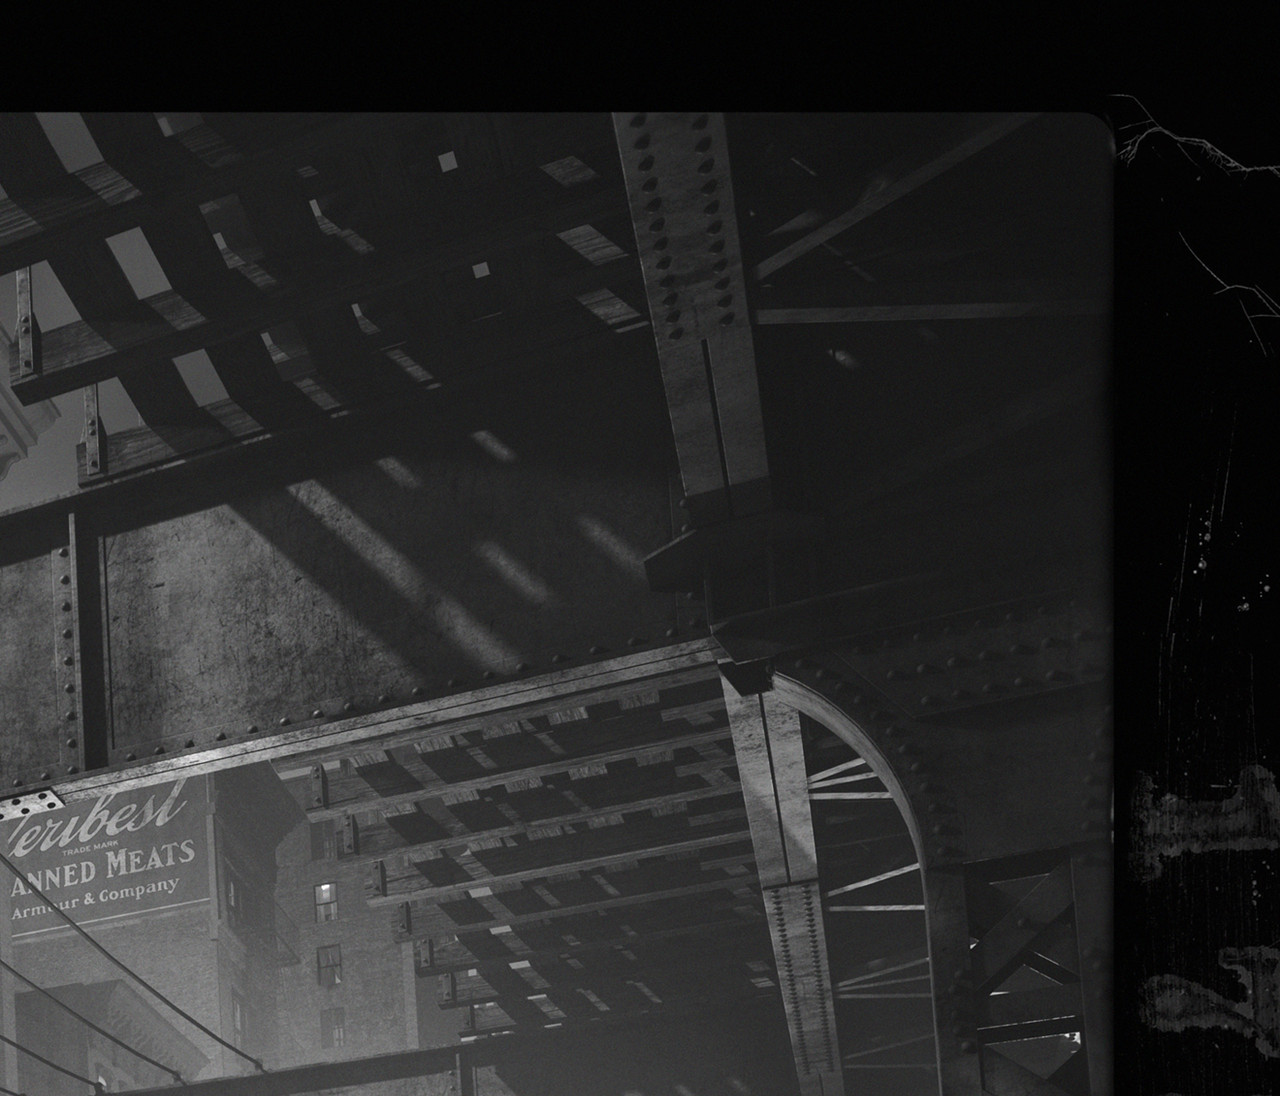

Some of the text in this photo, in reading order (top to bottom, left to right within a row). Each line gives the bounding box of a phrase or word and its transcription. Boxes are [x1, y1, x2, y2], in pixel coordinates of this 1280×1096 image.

[8, 778, 188, 858] eribest
[62, 839, 120, 857] TRADE MARK
[105, 838, 196, 879] MEATS
[83, 891, 96, 907] &
[99, 877, 181, 903] Company
